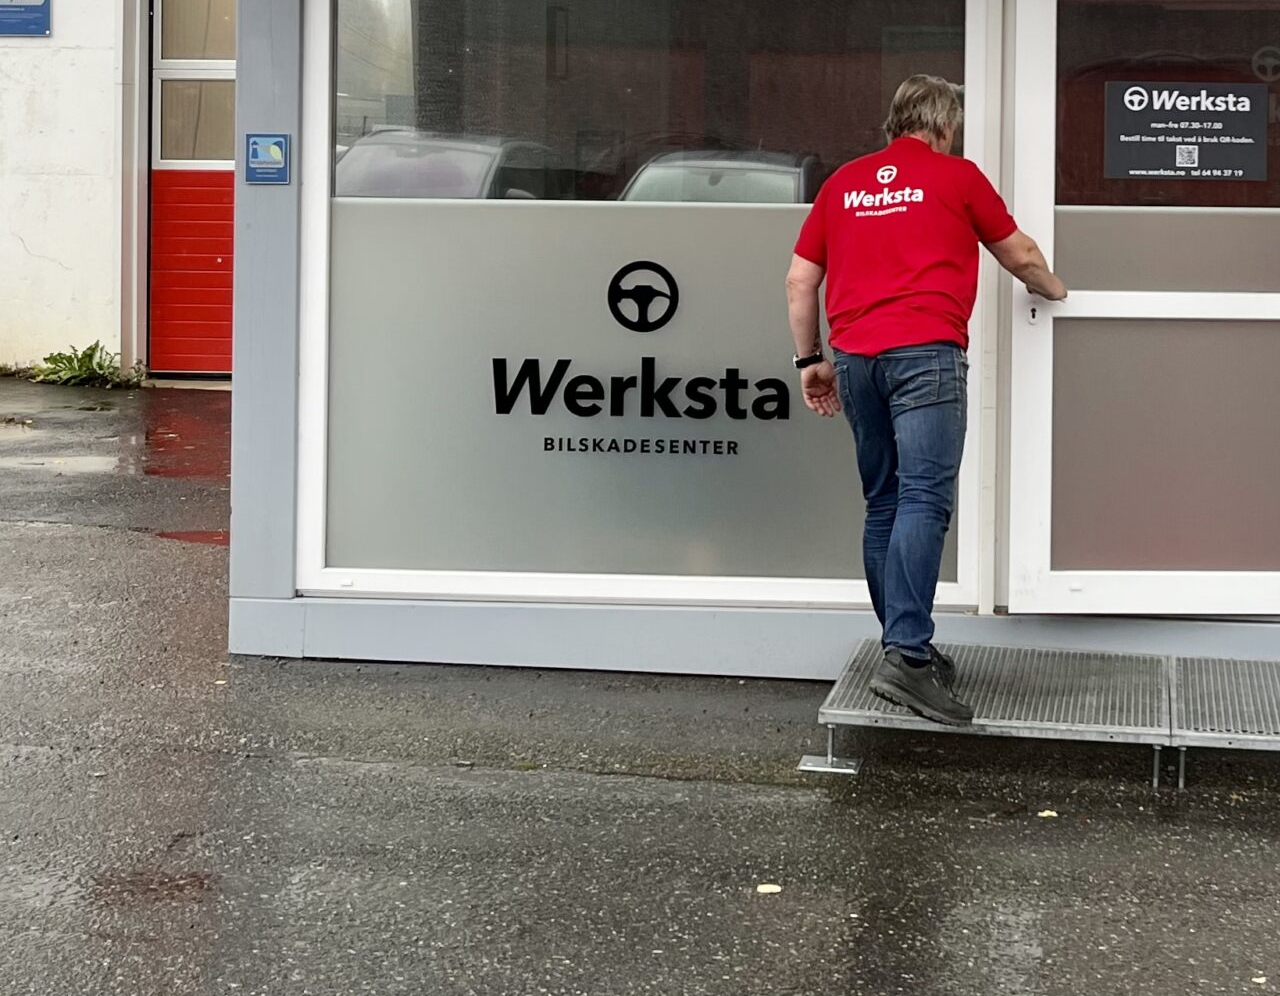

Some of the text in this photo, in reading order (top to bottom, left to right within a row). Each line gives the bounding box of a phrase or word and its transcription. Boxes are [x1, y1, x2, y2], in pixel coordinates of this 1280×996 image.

[1152, 90, 1251, 112] Werksta
[843, 187, 924, 209] Werksta
[492, 357, 790, 420] Werksta
[543, 437, 739, 455] BILSKADESENTER
